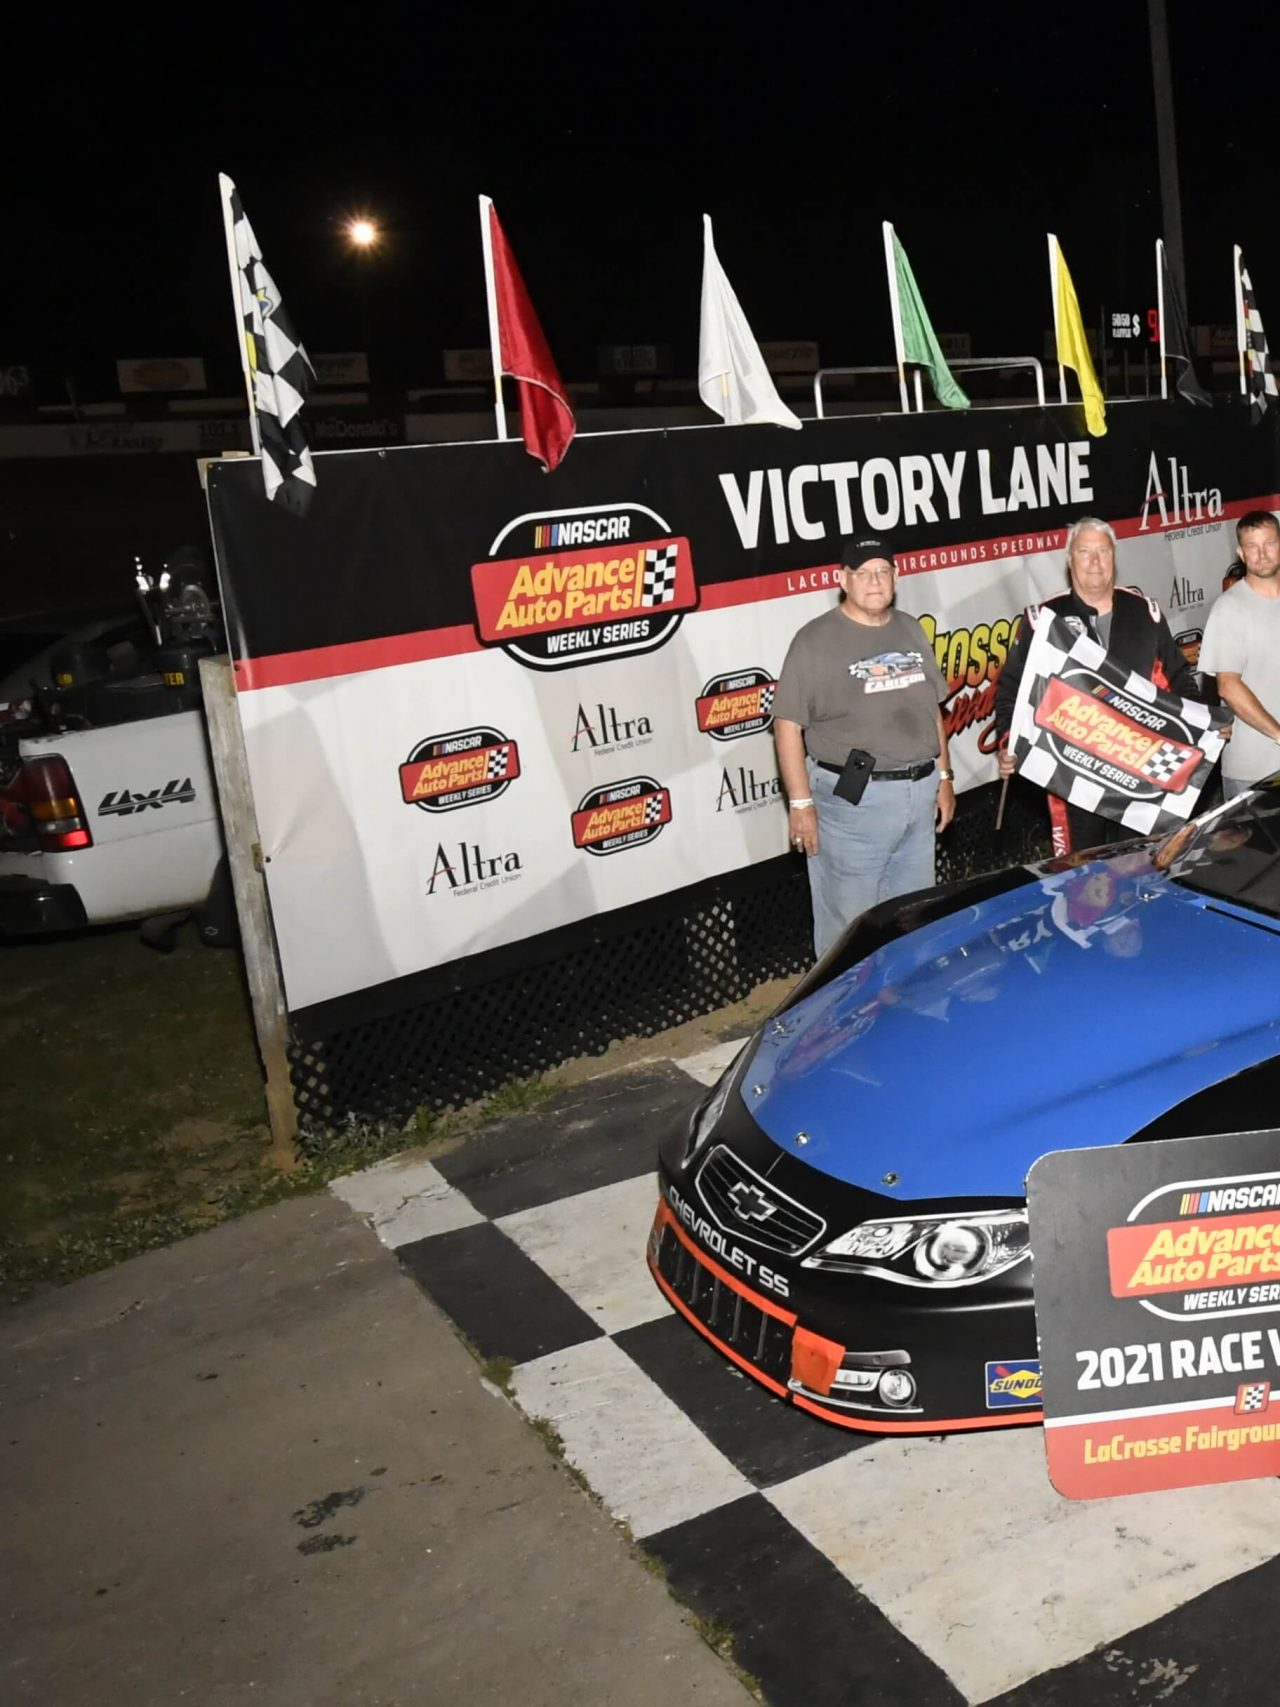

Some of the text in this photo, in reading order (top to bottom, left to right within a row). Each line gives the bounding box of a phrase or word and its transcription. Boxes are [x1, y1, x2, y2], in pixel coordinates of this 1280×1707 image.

[718, 441, 1094, 550] VICTORY LANE
[1138, 450, 1225, 531] Altra
[557, 516, 631, 546] NASCAR
[1205, 522, 1222, 535] Union
[786, 533, 1060, 592] LACRO IRGROUNDS SPEEDWAY
[508, 557, 635, 601] Advance
[1169, 575, 1205, 609] Altra
[495, 586, 634, 631] Auto Parts
[547, 620, 650, 653] WEEKLY SERIES
[728, 675, 756, 690] NASCAR
[705, 705, 757, 726] Auto Parts
[710, 691, 757, 714] Advance
[1108, 695, 1168, 731] NASCAR
[571, 702, 654, 752] Altra
[1058, 695, 1153, 749] Advance
[445, 736, 482, 753] NASCAR
[635, 737, 653, 746] Union
[1046, 709, 1088, 740] Auto
[1084, 732, 1138, 767] Parts
[421, 755, 484, 780] Advance
[1063, 744, 1140, 790] WEEKLY SERIES
[98, 777, 196, 816] 4x4
[412, 770, 484, 796] Auto Parts
[438, 784, 492, 805] WEEKLY SERIES
[609, 784, 641, 800] NASCAR
[716, 766, 783, 813] Altra
[582, 817, 641, 842] Auto Parts
[588, 802, 642, 828] Advance
[627, 829, 648, 842] SERIES
[425, 842, 523, 895] Altra
[453, 873, 521, 897] Federal Credit Union
[668, 1185, 790, 1298] CHEVROLET SS
[1126, 1256, 1205, 1288] Auto
[1184, 1286, 1247, 1311] WEEKLY
[1076, 1342, 1165, 1391] 2021
[1171, 1331, 1265, 1378] RACE
[993, 1378, 1043, 1392] SUNOC
[1083, 1434, 1181, 1465] LaCrosse
